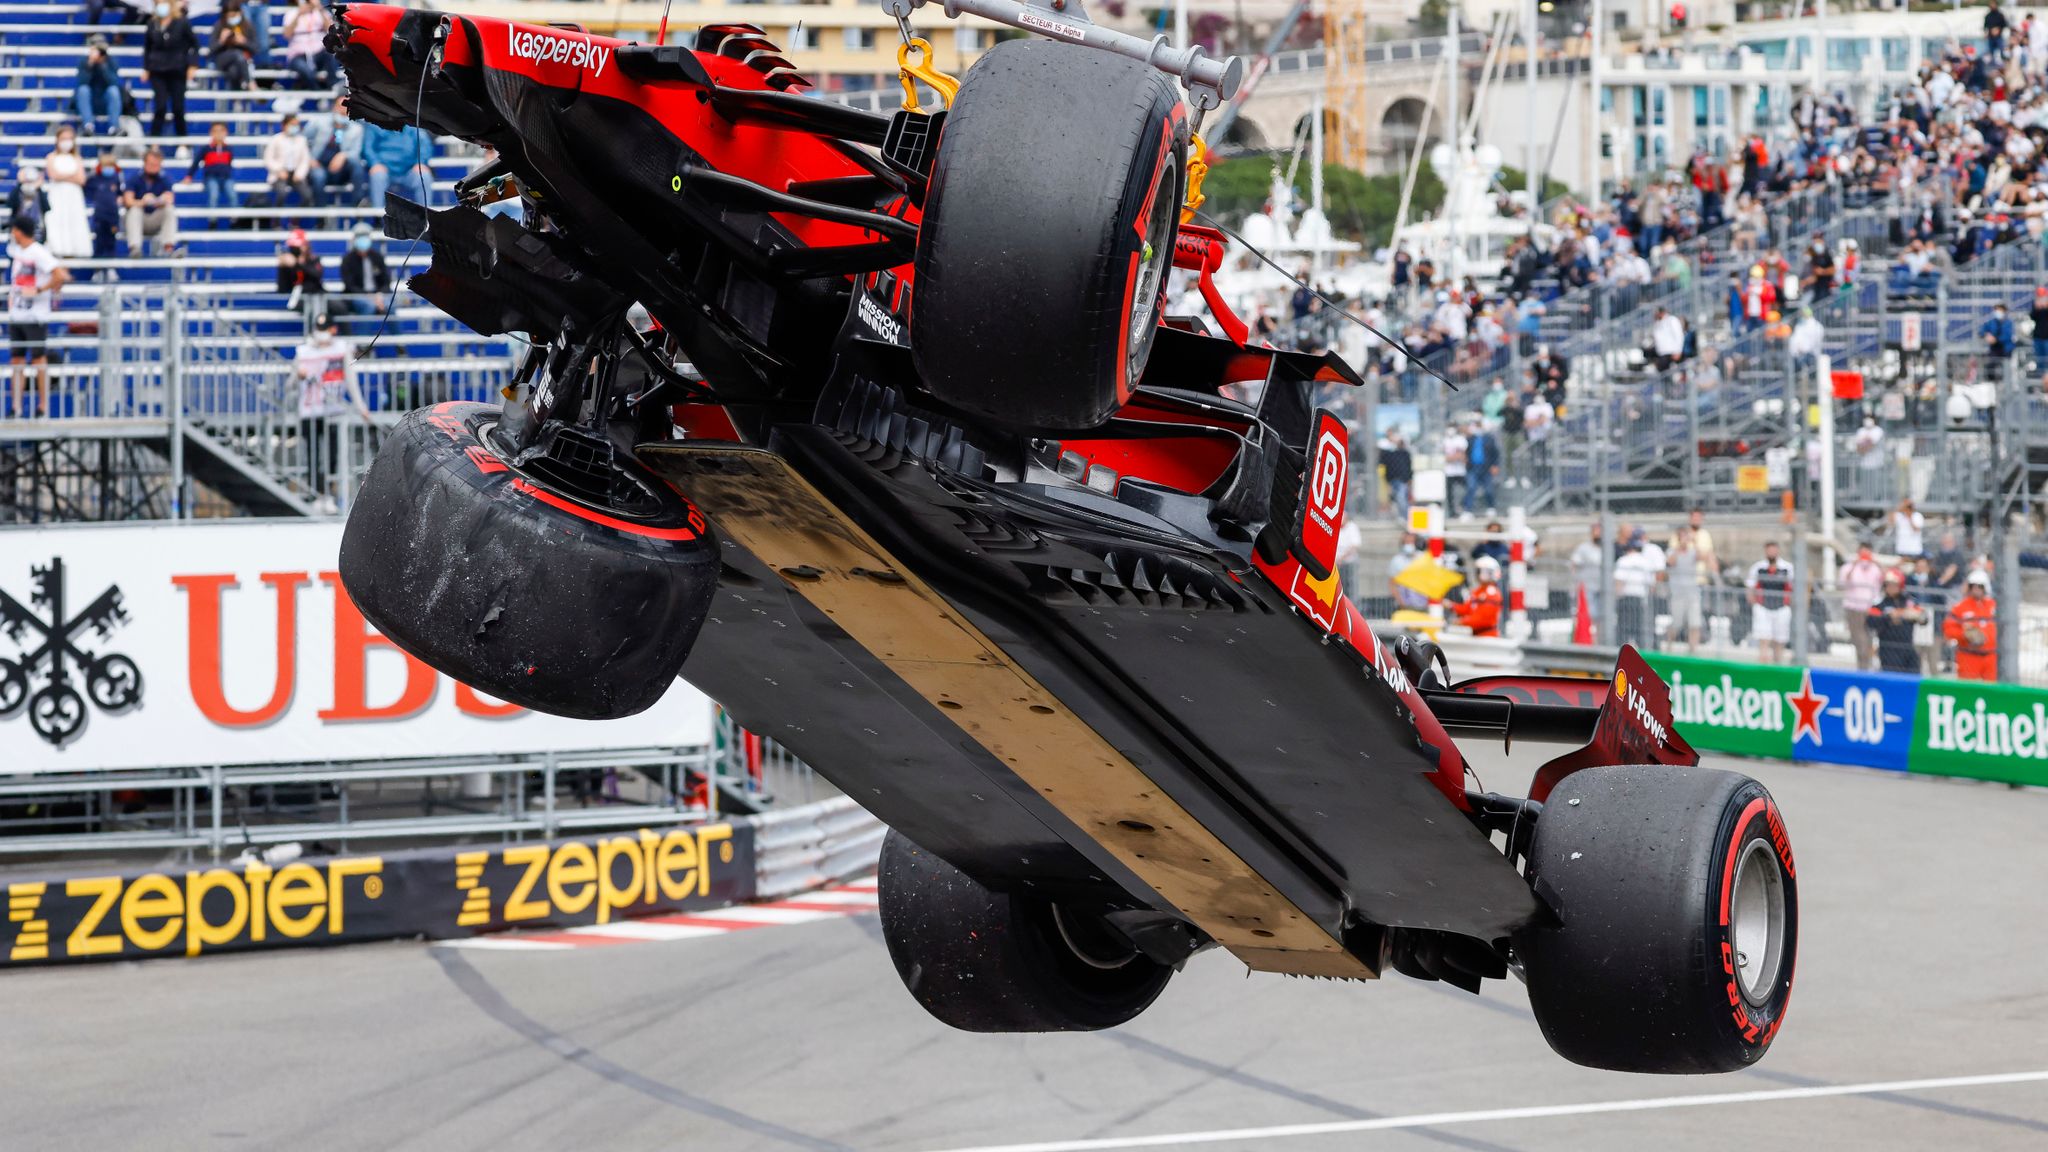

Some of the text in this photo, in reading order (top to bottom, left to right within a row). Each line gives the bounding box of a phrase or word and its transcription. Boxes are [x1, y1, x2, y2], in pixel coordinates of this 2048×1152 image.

[508, 23, 610, 78] kaspersky
[1022, 14, 1081, 38] SECTEUR 15 Alpha
[858, 303, 899, 345] WINNOW
[860, 293, 901, 335] MISSION
[171, 571, 533, 726] UB
[1672, 670, 1785, 732] ineken
[1927, 694, 2048, 760] Heinek
[503, 823, 733, 925] zepter
[66, 856, 384, 958] zepter
[1721, 941, 1761, 1044] ZERO
